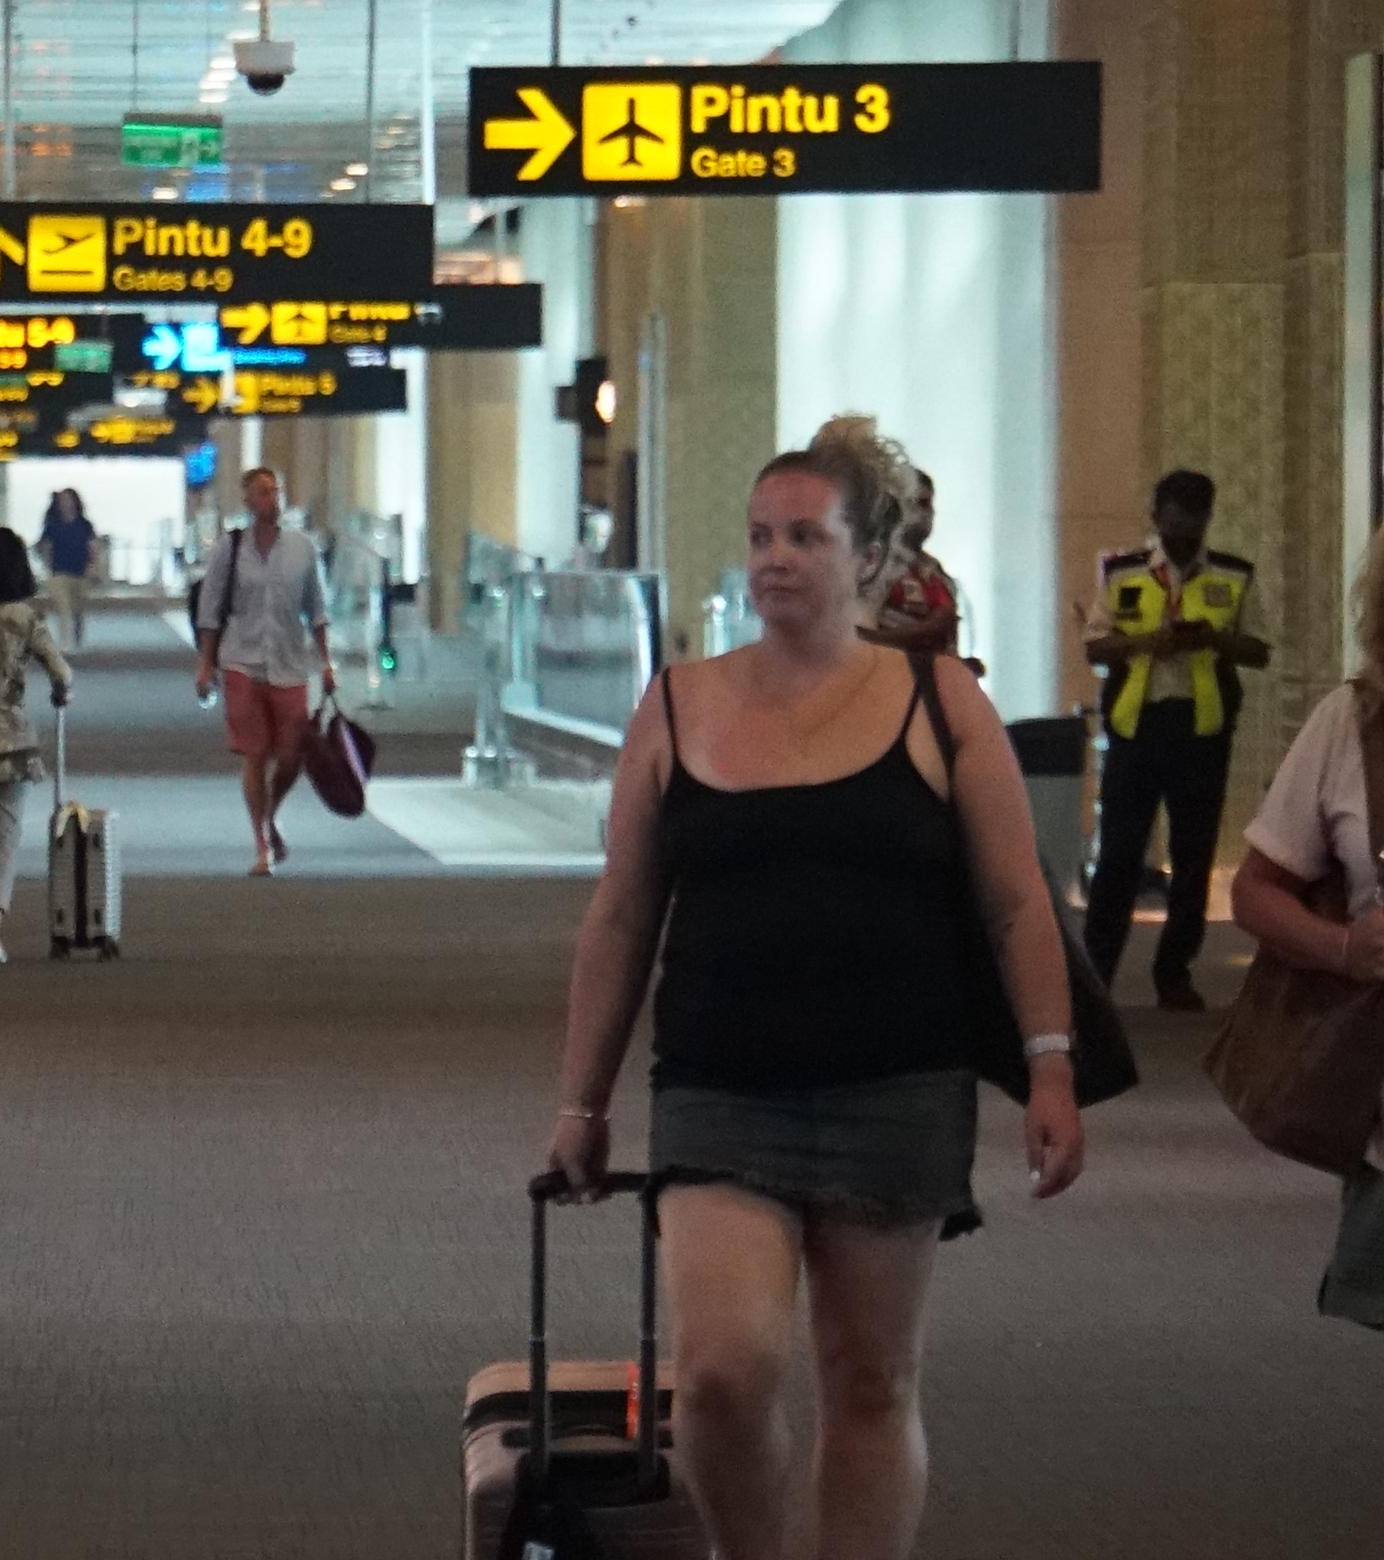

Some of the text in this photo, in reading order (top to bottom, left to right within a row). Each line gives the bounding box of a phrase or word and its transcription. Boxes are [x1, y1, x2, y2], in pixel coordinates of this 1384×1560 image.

[690, 83, 891, 134] Pintu 3
[690, 146, 796, 178] Gate 3
[113, 217, 313, 259] Pintu 4-9
[113, 265, 234, 292] Gates 4-9
